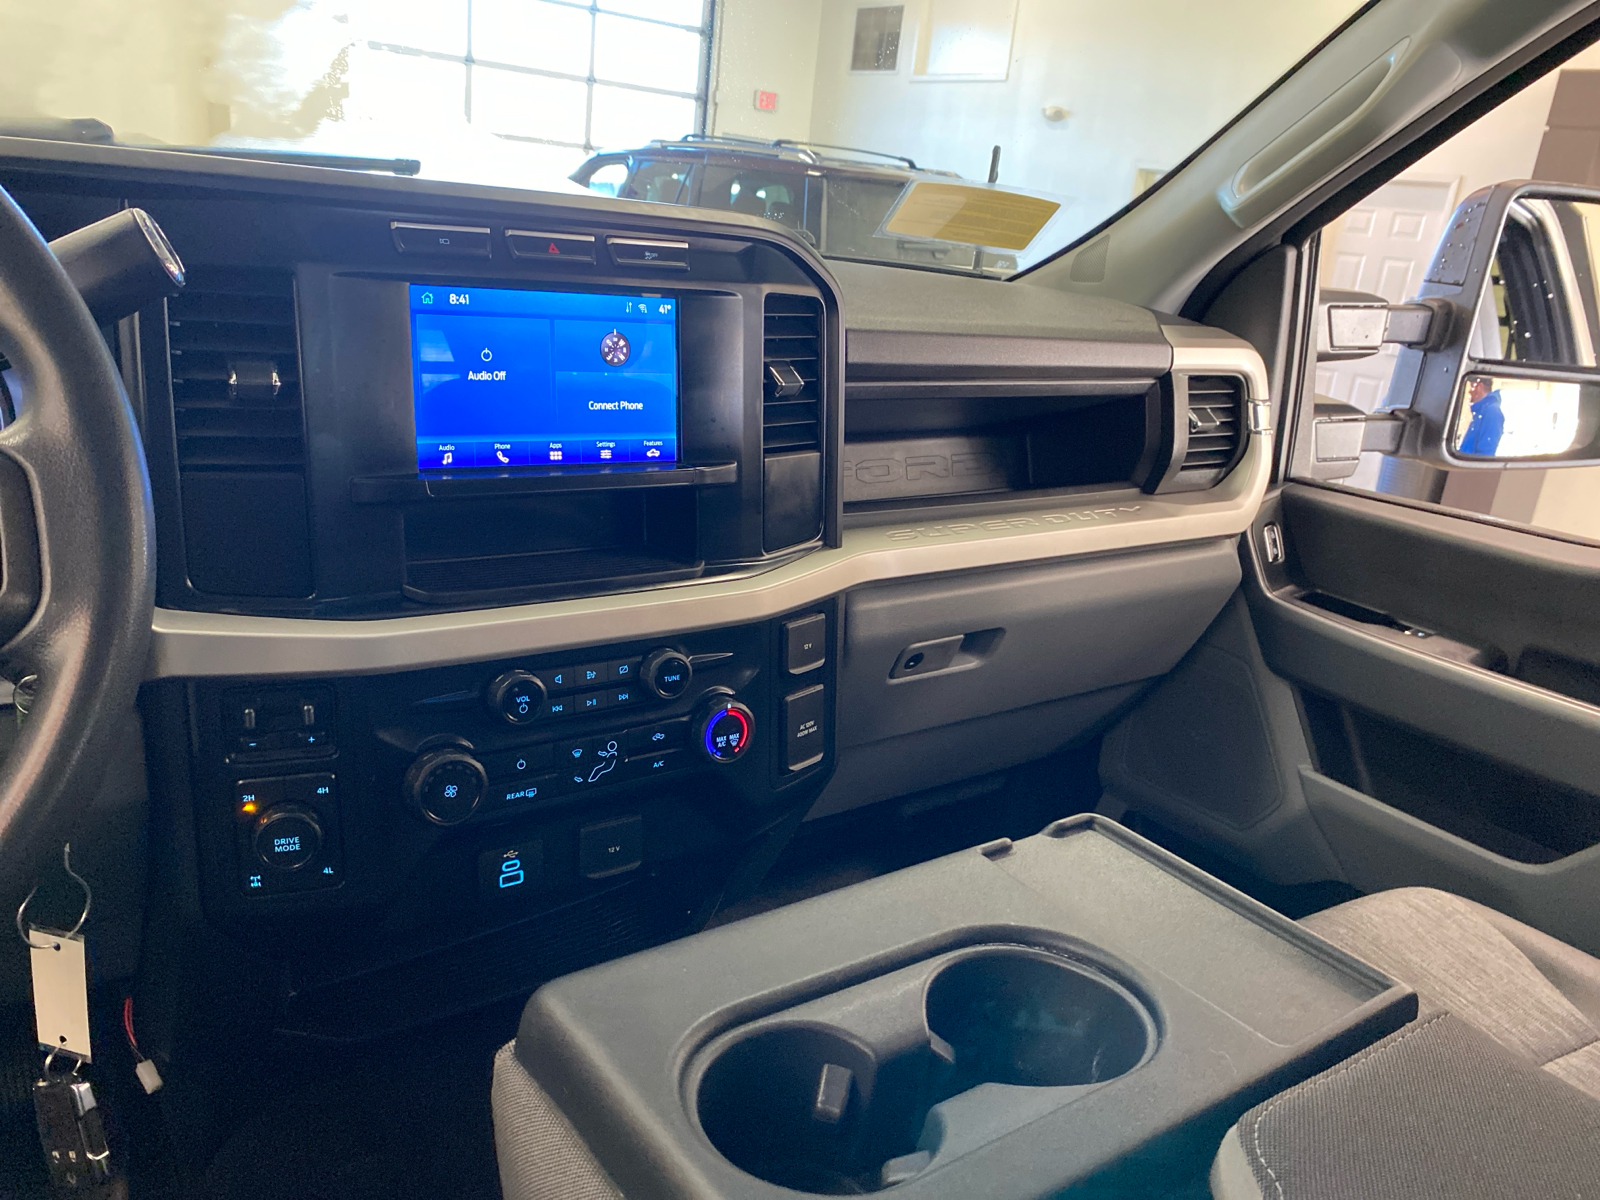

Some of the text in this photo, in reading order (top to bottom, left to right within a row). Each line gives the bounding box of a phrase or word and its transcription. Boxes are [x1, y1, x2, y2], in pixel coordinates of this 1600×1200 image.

[449, 293, 470, 305] 8:41
[468, 371, 507, 381] Audio Off
[588, 401, 643, 411] Connect Phone
[596, 440, 616, 448] Settings
[844, 452, 996, 484] ORD
[885, 504, 1142, 541] SUPER DUTY
[664, 674, 681, 682] TUNE
[515, 695, 531, 703] VOL
[716, 735, 727, 743] MAX
[729, 732, 740, 740] MAX
[653, 760, 664, 768] A/C
[506, 790, 525, 800] REAR
[274, 836, 300, 846] DRIVE
[274, 843, 301, 853] MODE
